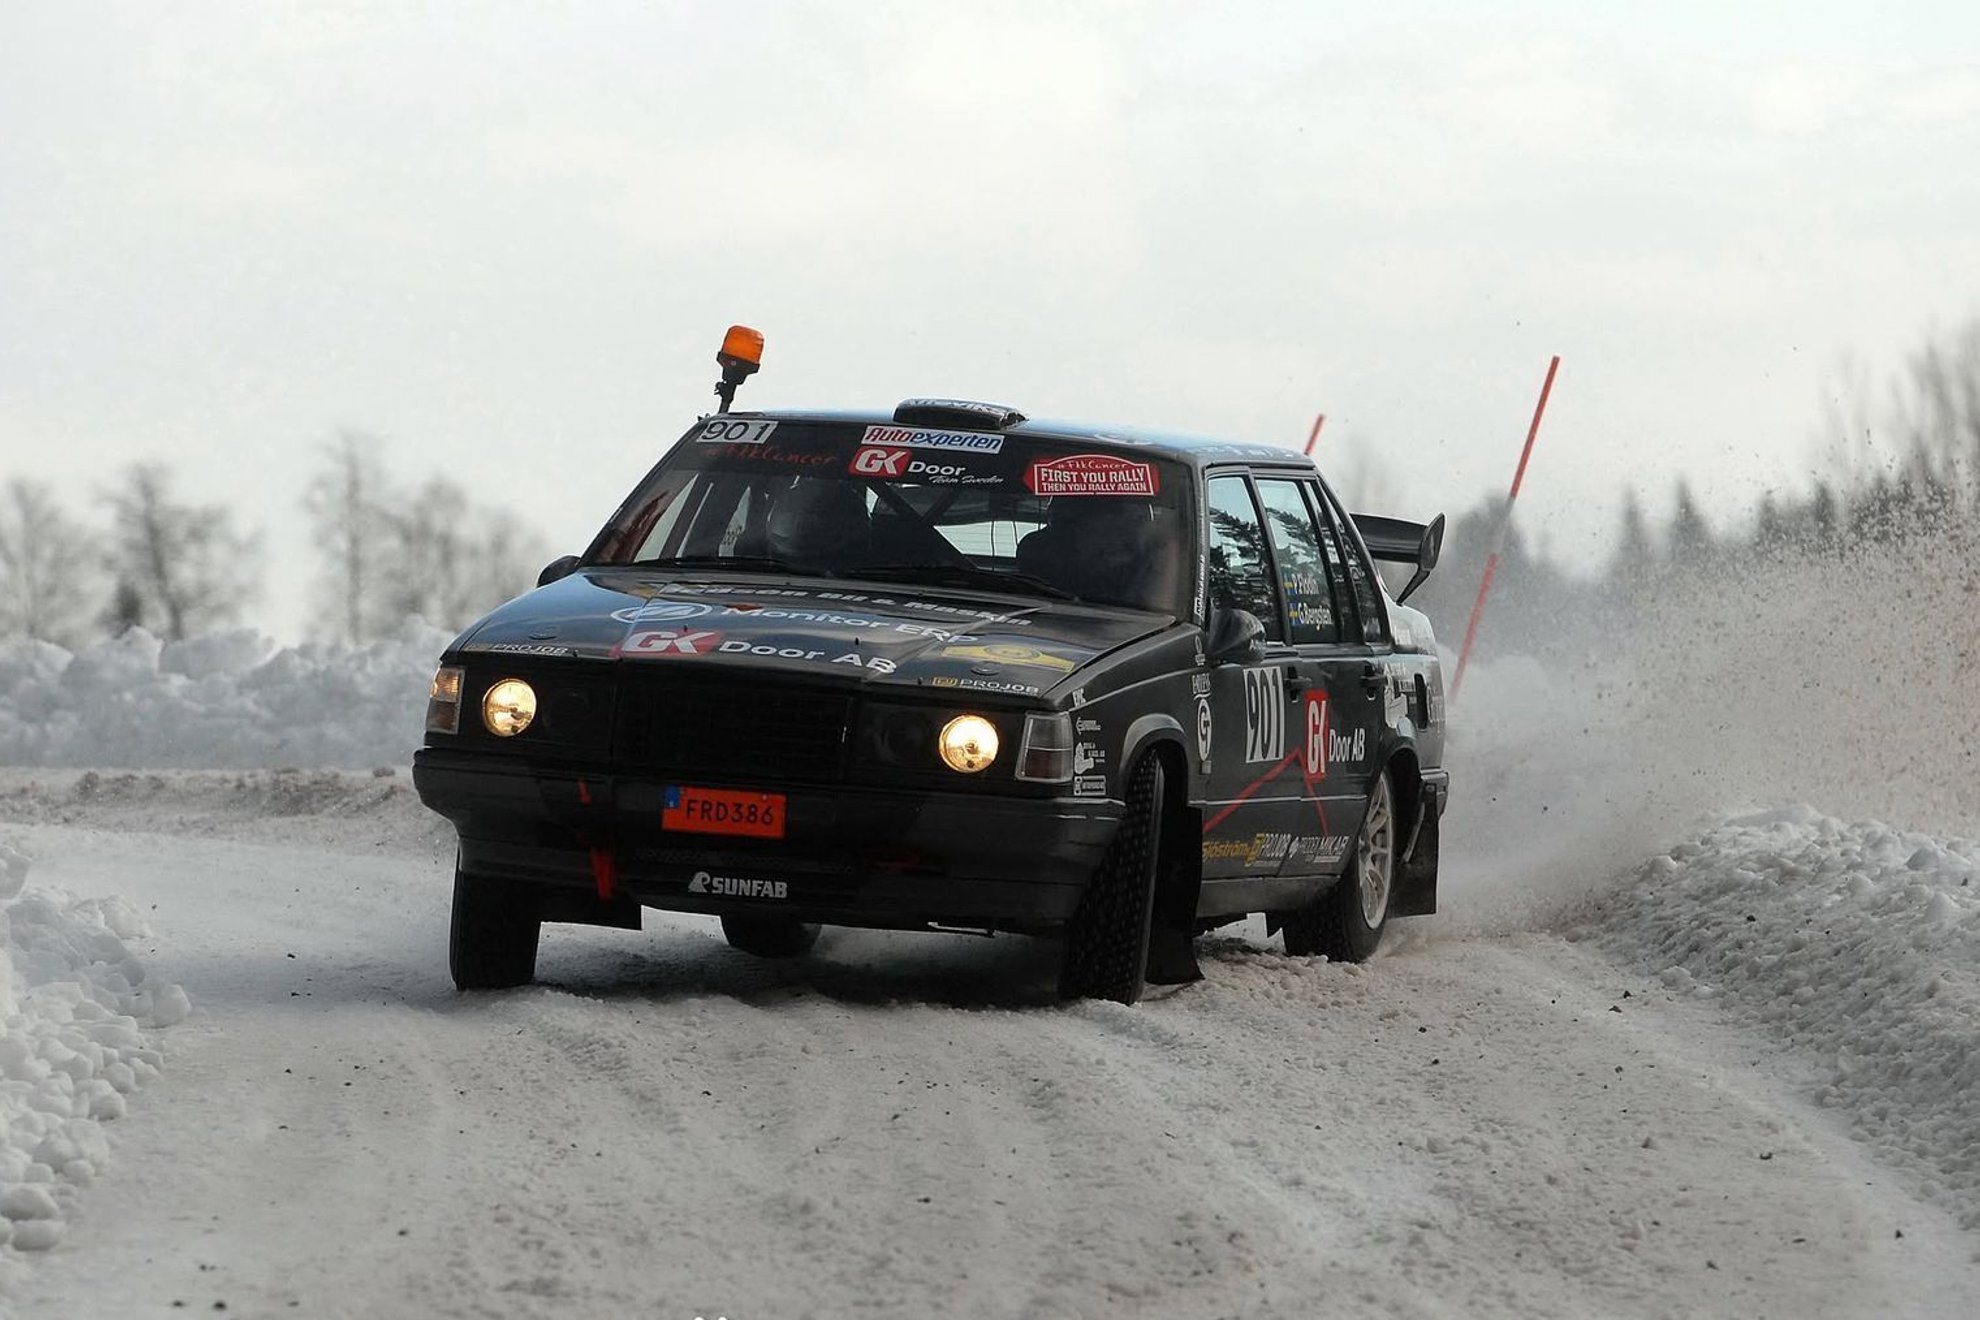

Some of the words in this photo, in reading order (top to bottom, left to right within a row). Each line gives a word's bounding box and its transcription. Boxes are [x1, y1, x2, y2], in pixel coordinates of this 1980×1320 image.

[701, 421, 771, 441] 901
[866, 427, 1001, 450] Autoexperten
[855, 449, 907, 474] GK
[908, 461, 966, 476] Door
[1041, 468, 1079, 483] FIRST
[1081, 471, 1106, 483] YOU
[1110, 467, 1145, 482] RALLY
[1042, 482, 1066, 492] THEN
[1068, 482, 1087, 492] YOU
[1088, 482, 1115, 491] RALLY
[1118, 482, 1147, 492] AGAIN
[720, 605, 890, 628] Monitor
[896, 622, 979, 644] ERP
[620, 631, 717, 654] GK
[719, 641, 825, 660] Door
[831, 652, 897, 675] AB
[959, 679, 1040, 694] PROJOB
[1247, 668, 1281, 761] 901
[1307, 700, 1326, 774] GK
[1329, 728, 1351, 762] Door
[1351, 727, 1366, 762] AB
[685, 799, 775, 826] FRD386
[711, 877, 789, 899] SUNFAB
